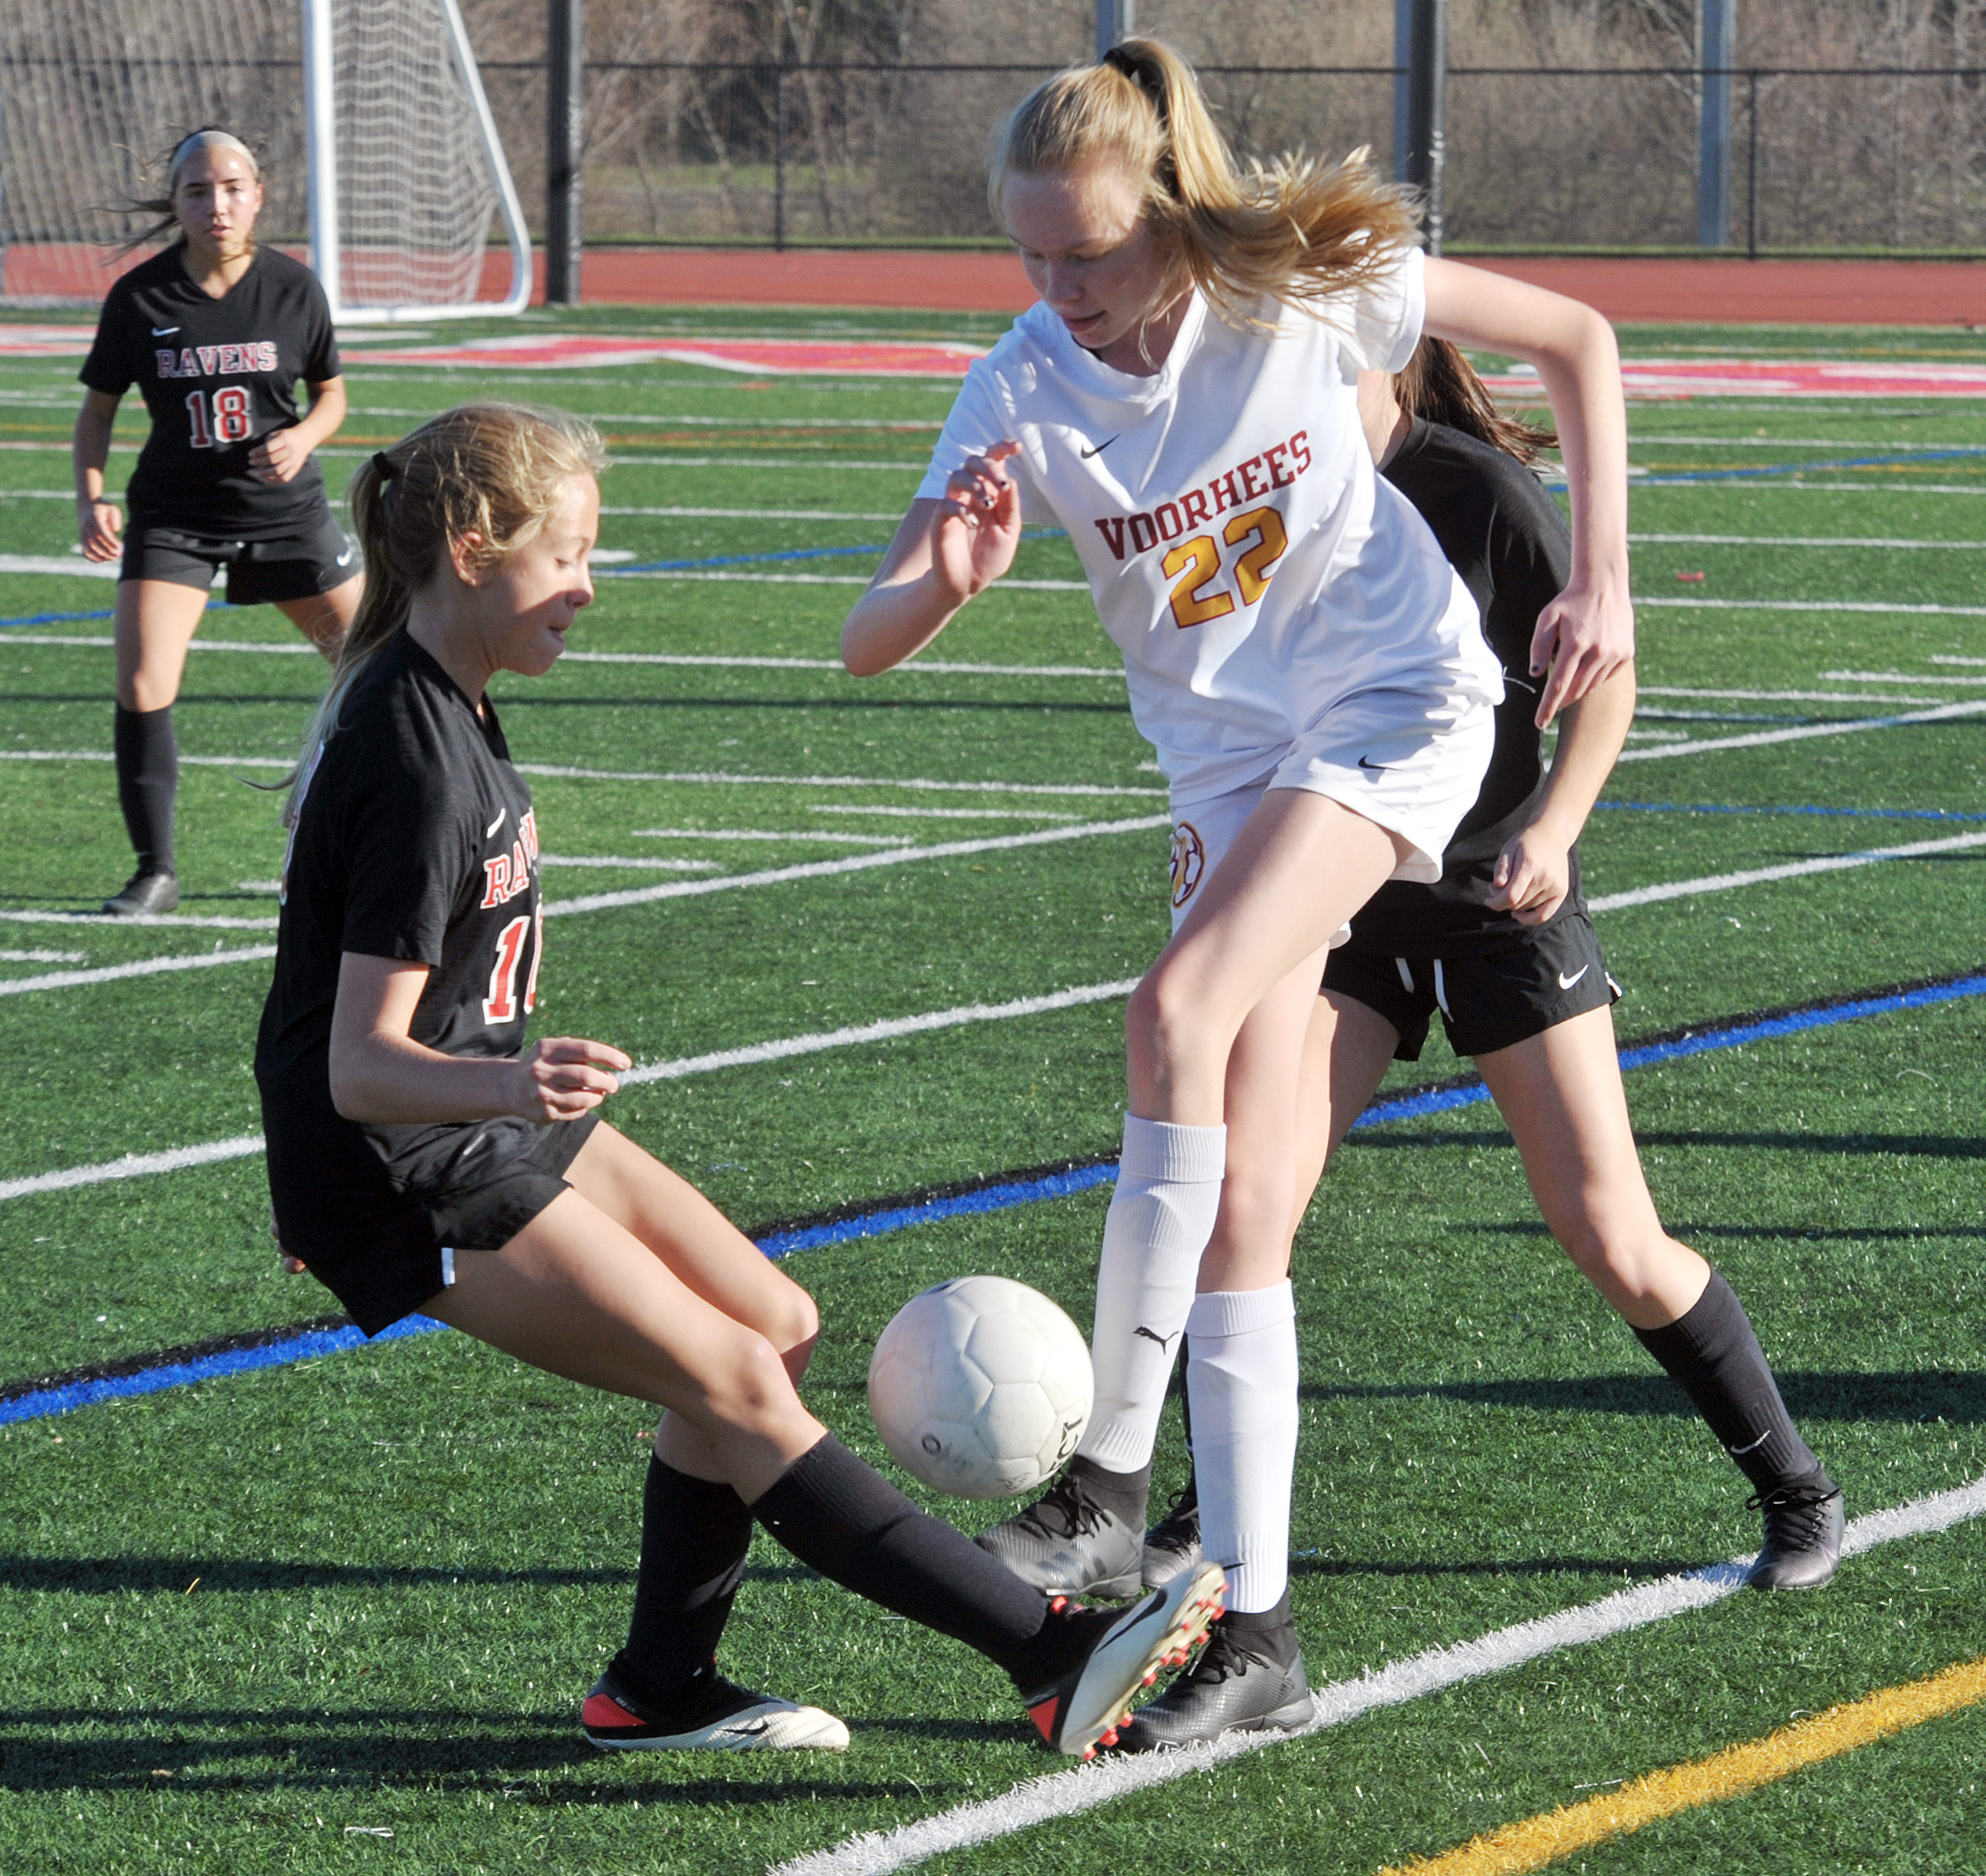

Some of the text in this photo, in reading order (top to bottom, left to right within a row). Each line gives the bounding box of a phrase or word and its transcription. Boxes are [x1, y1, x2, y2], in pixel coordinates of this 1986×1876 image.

[155, 341, 278, 378] RAVENS
[185, 385, 252, 449] 18
[1094, 430, 1311, 560] VOORHEES
[1161, 505, 1289, 630] 22
